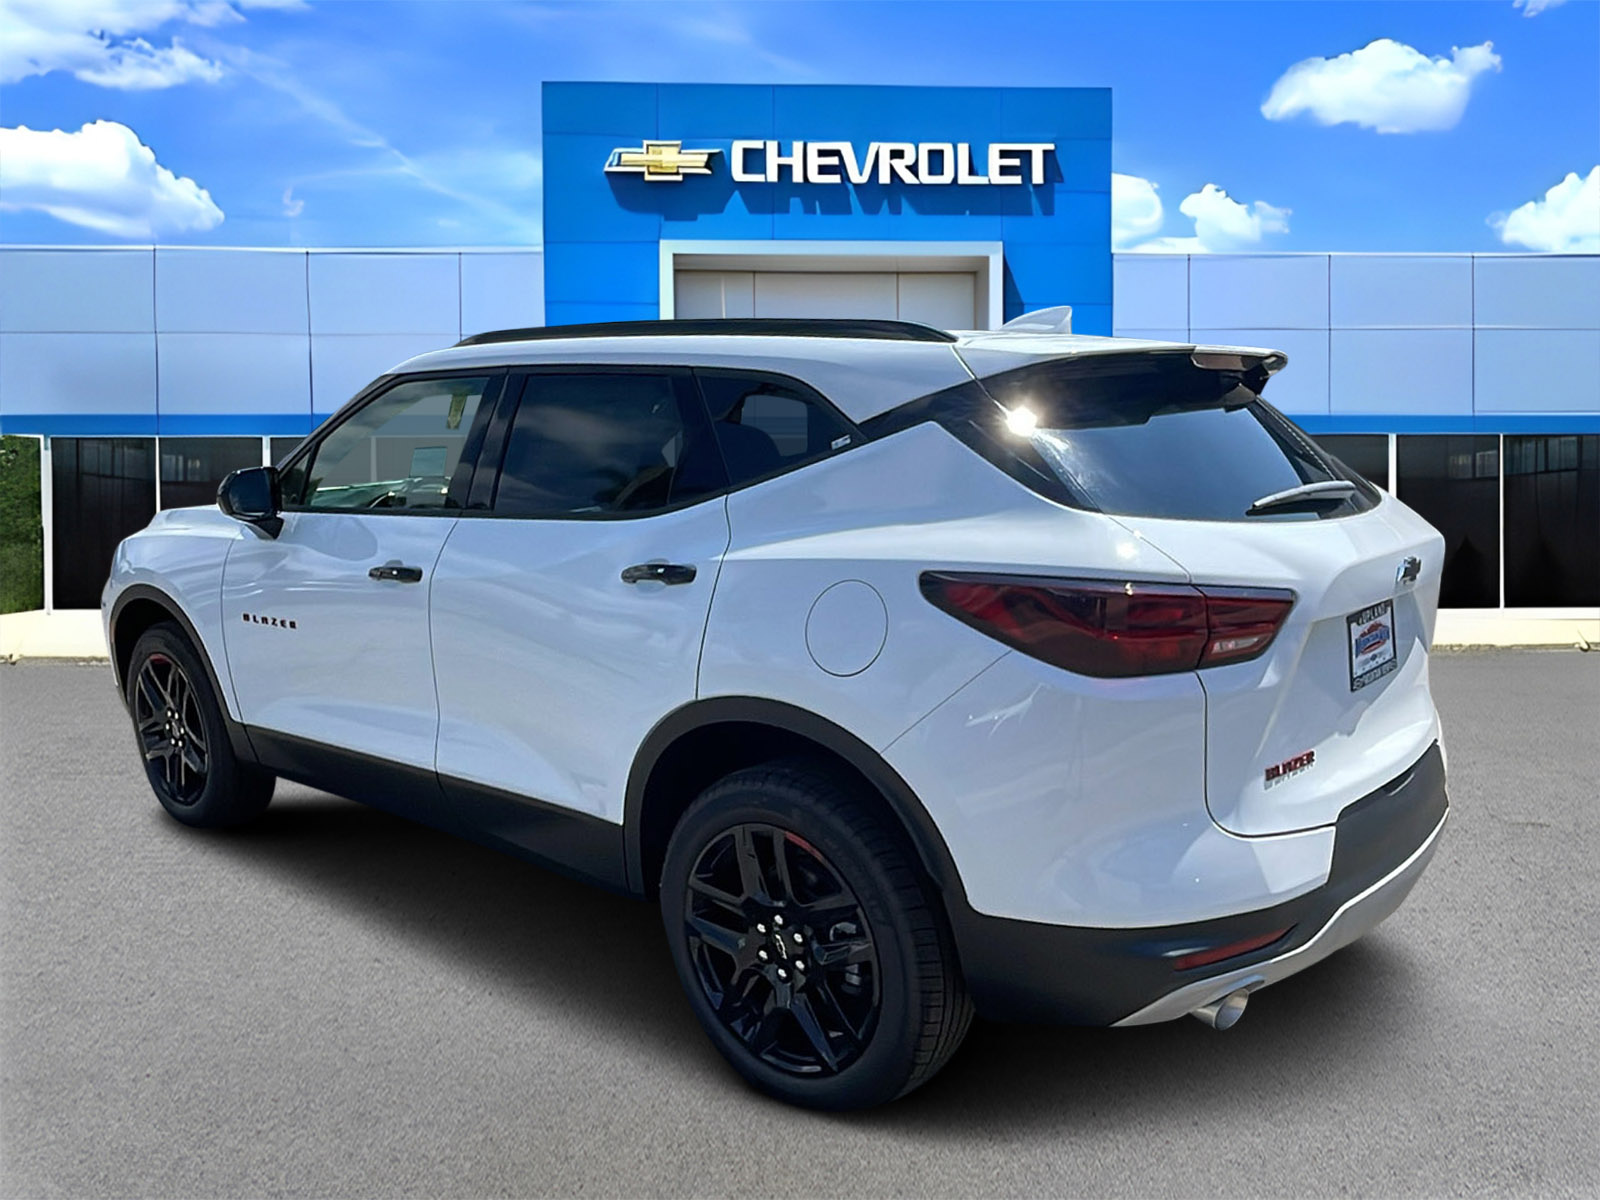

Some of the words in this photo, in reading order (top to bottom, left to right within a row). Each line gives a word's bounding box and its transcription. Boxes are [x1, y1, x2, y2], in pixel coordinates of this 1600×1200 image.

[730, 140, 1055, 185] CHEVROLET
[242, 612, 297, 630] BLAZER
[1264, 750, 1316, 782] BLAZER
